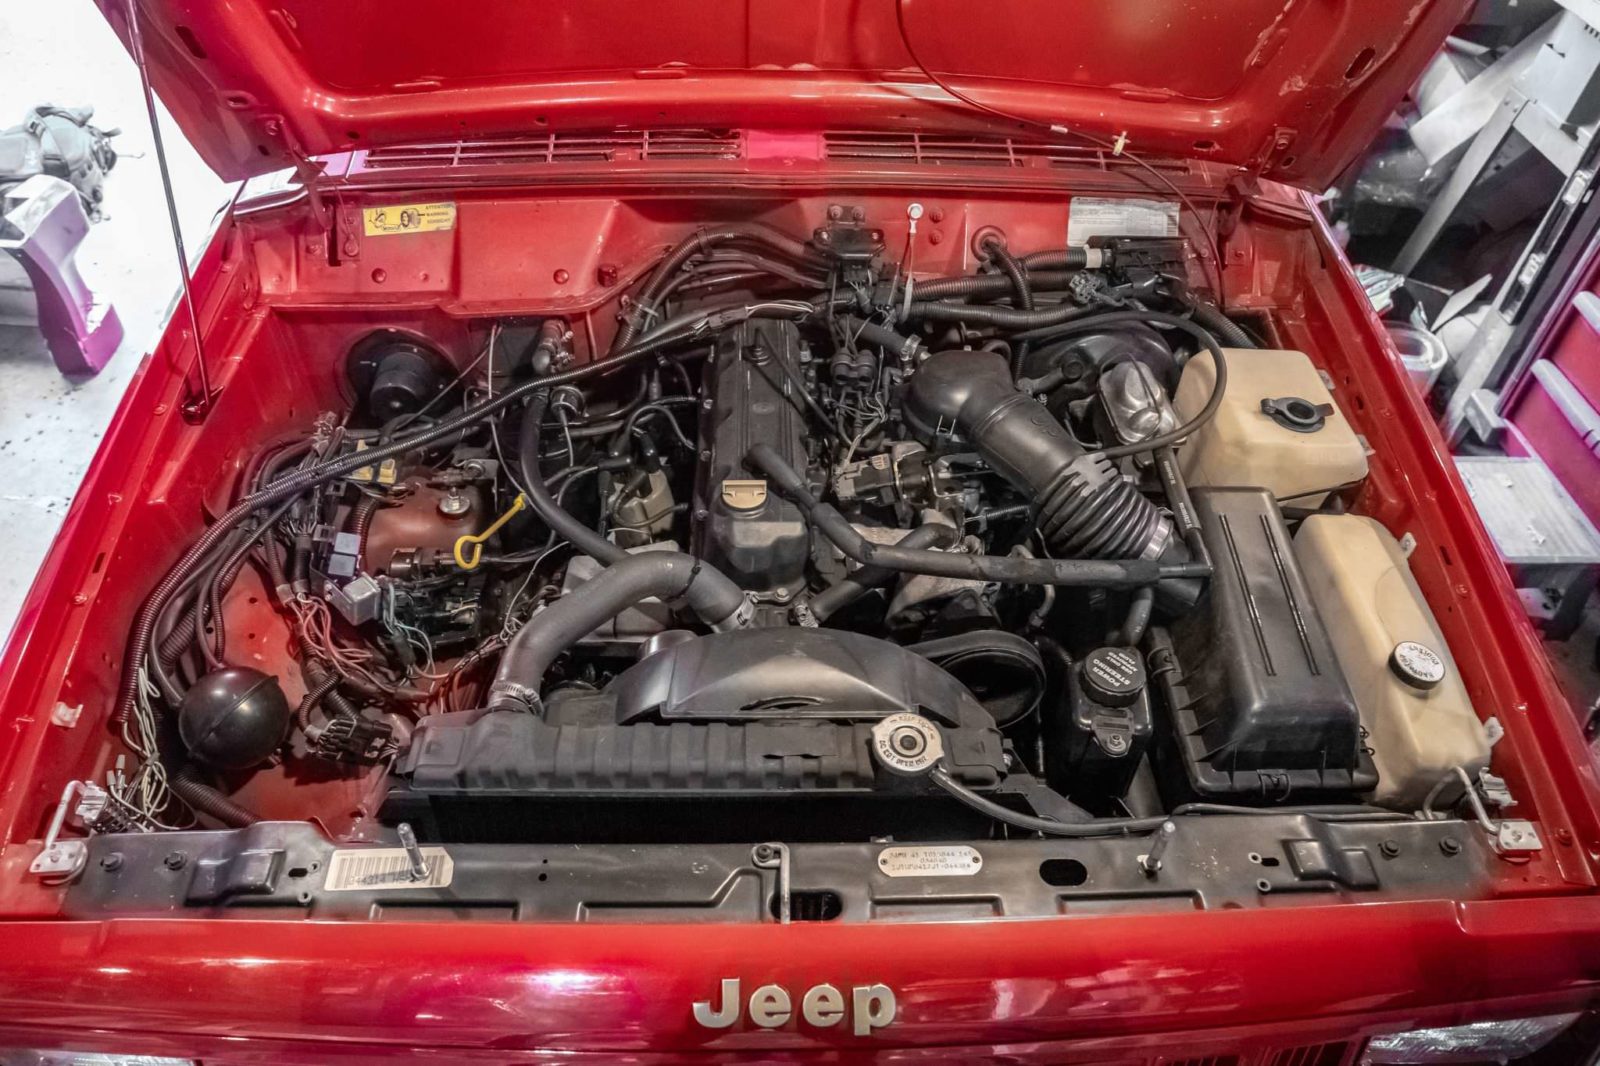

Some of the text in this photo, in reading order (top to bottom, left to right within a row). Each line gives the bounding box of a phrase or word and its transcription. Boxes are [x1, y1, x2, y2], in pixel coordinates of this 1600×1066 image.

[1093, 667, 1120, 686] POWER
[1094, 659, 1130, 685] STEERING
[693, 977, 896, 1036] Jeep
